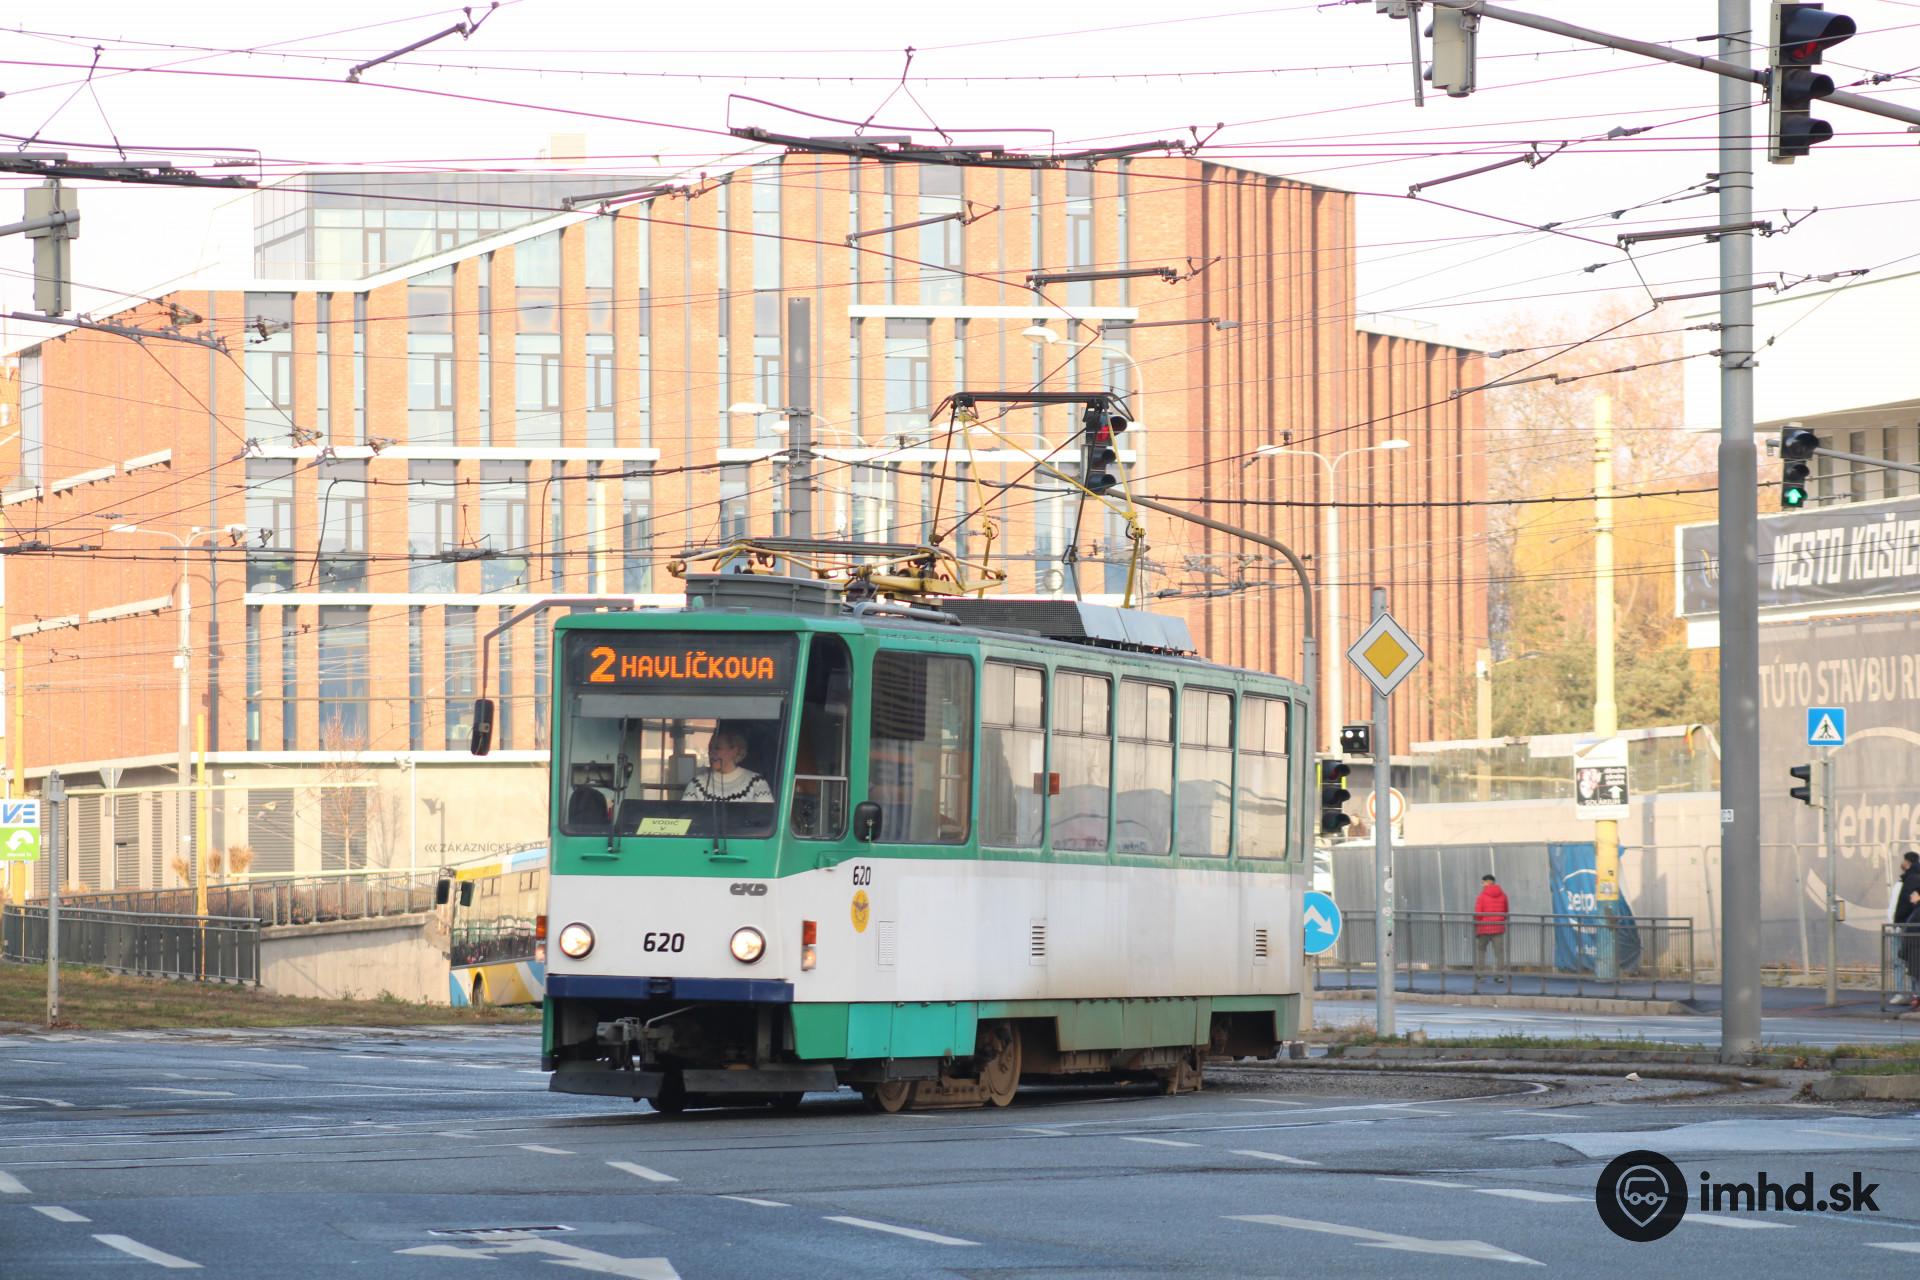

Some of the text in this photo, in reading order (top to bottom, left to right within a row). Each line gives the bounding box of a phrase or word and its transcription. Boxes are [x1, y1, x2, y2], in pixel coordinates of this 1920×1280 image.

[1772, 527, 1845, 590] MESTO
[590, 646, 774, 682] 2 HAVLÍČKOVA
[1759, 654, 1812, 708] TÚTO
[1816, 655, 1897, 705] STAVBU
[853, 865, 871, 886] 620
[643, 931, 686, 953] 620
